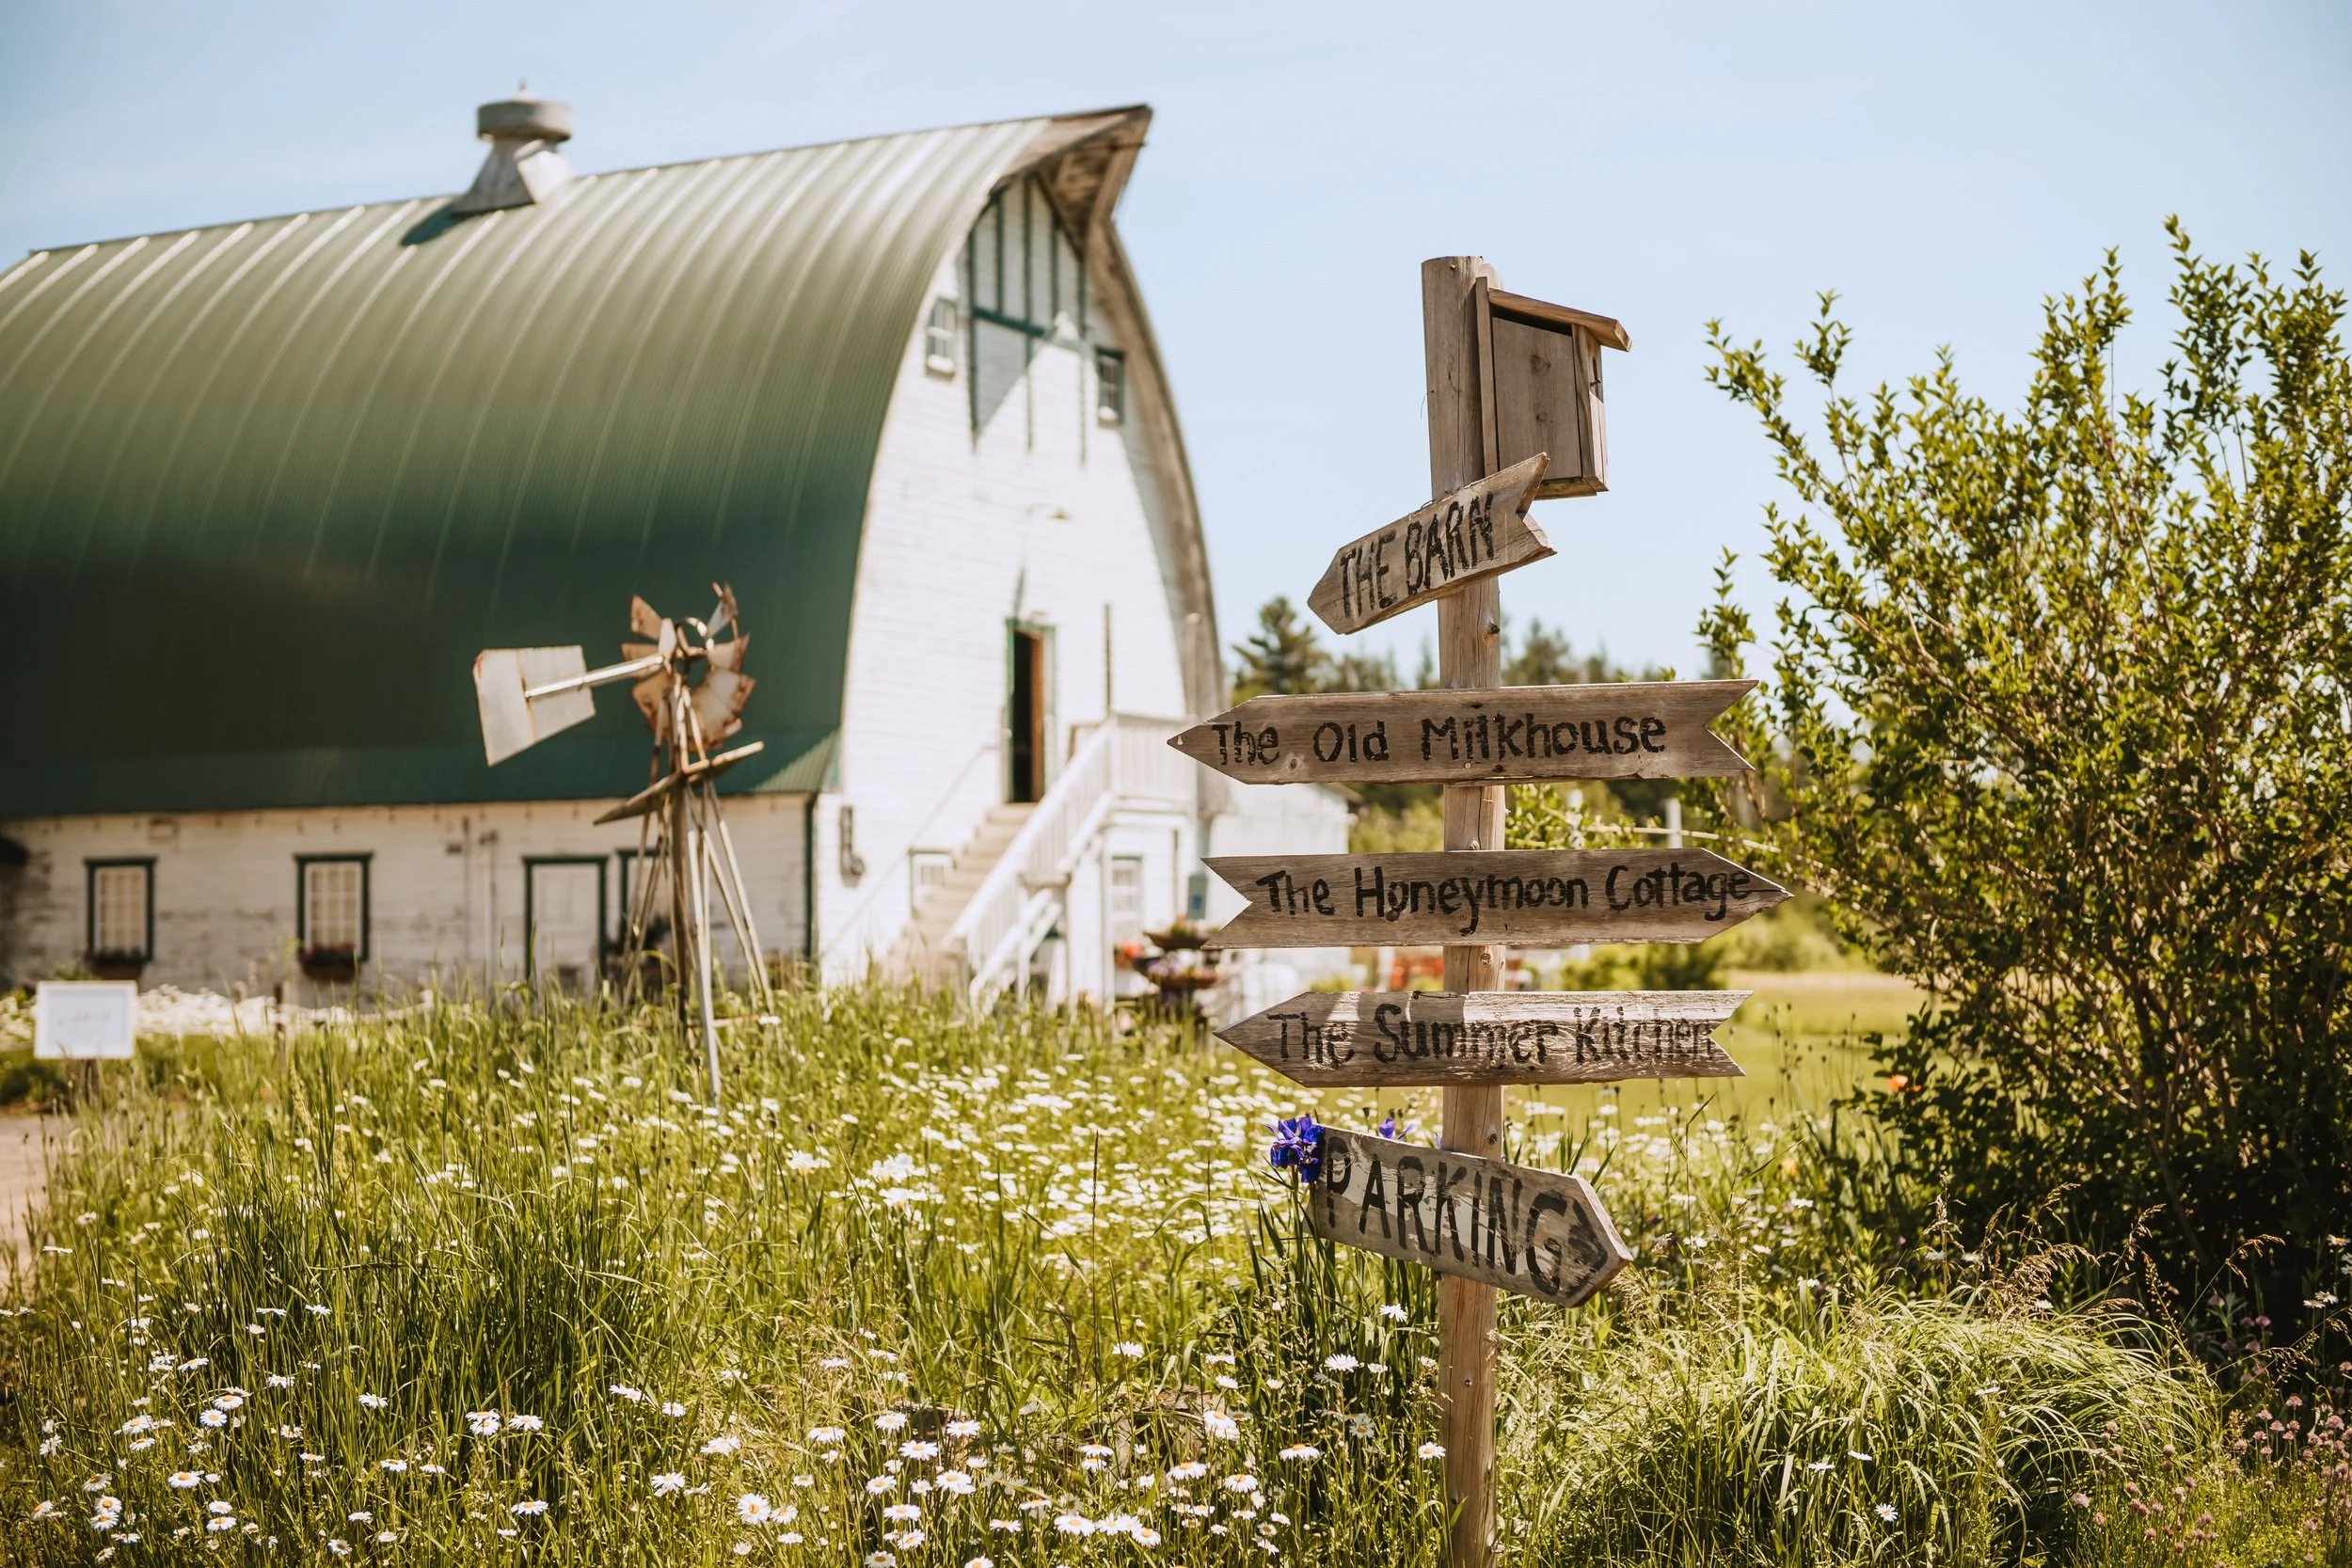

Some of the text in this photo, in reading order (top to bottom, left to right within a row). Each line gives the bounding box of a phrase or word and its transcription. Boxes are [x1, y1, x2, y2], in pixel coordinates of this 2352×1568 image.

[1340, 490, 1494, 618] THE BARN
[1212, 712, 1667, 766] The Old Milkhouse
[1255, 862, 1751, 937] The Honeymoon Cottage
[1266, 1003, 1712, 1069] The Summer Kitchen
[1326, 1136, 1565, 1296] PARKING
